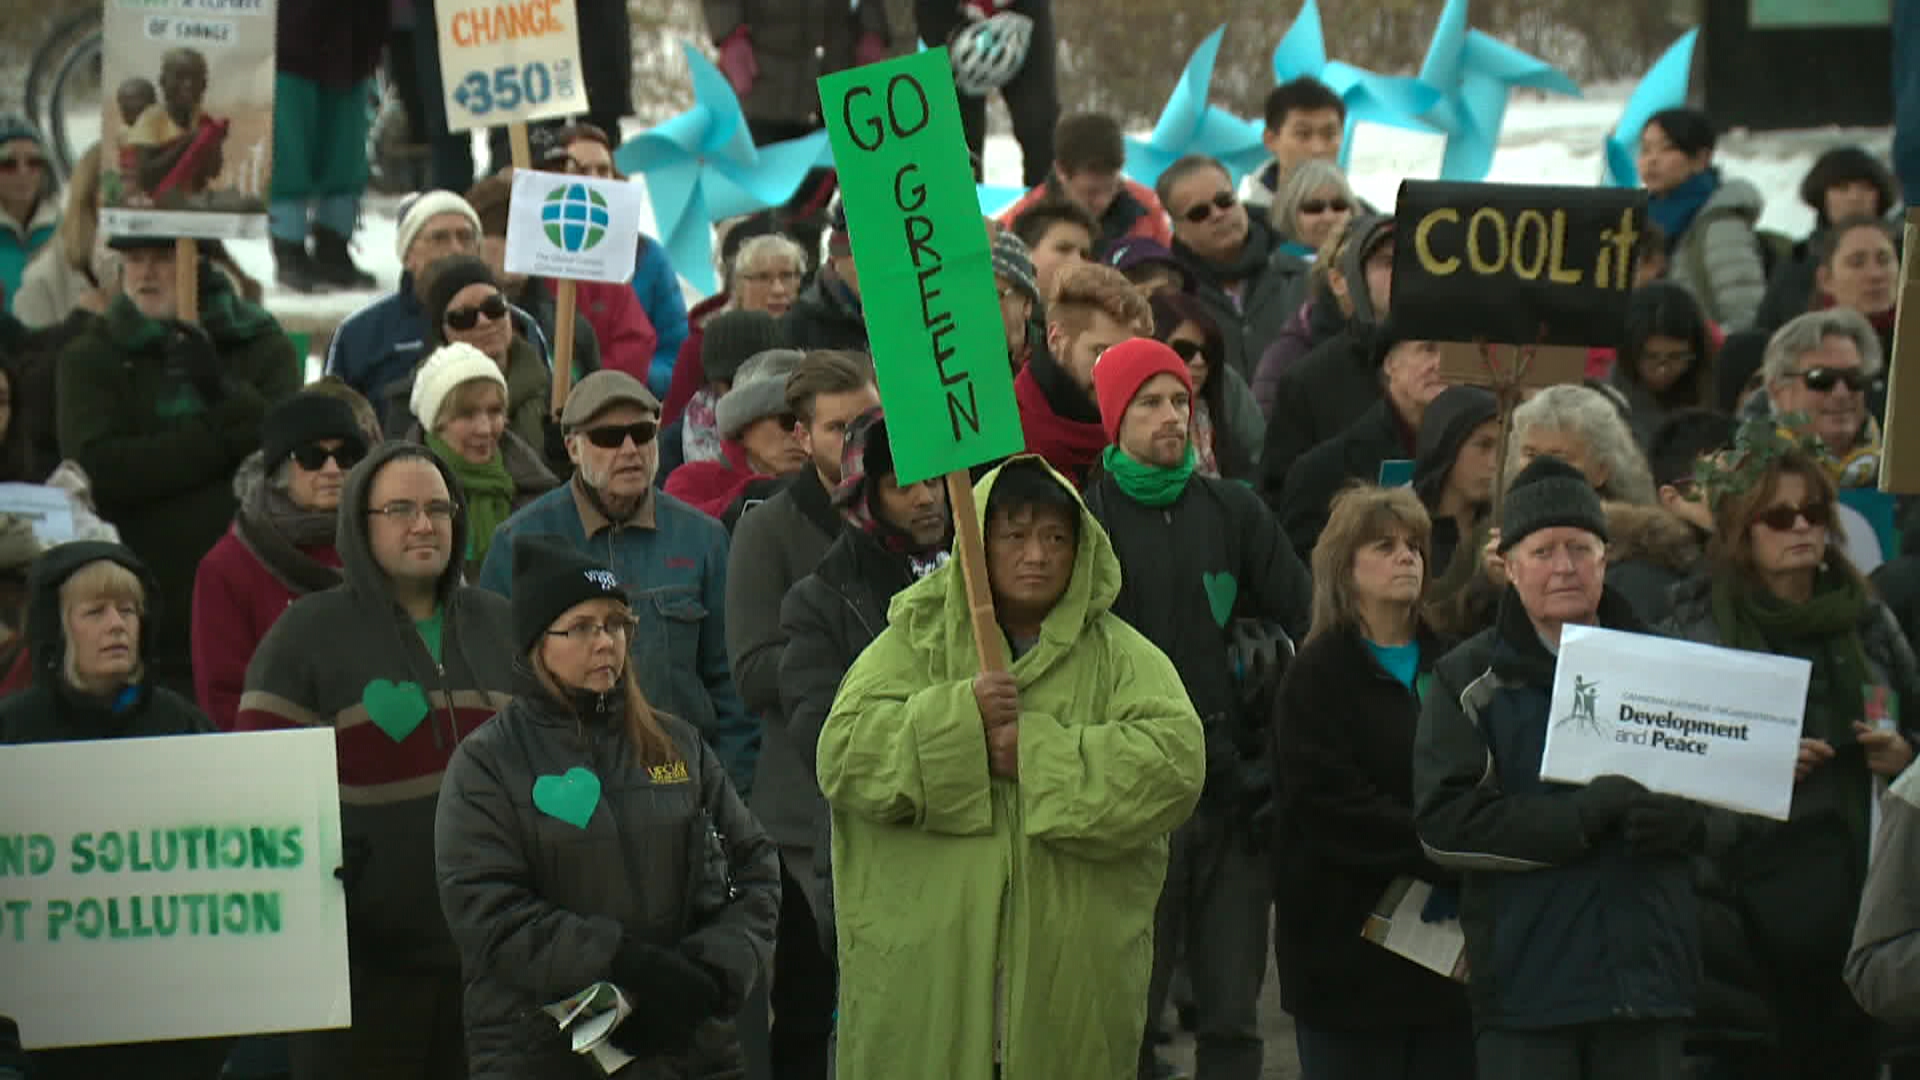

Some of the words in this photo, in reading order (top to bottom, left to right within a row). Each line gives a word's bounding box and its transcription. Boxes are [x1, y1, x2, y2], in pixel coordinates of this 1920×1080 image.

[452, 0, 565, 47] CHANGE
[464, 62, 551, 114] 350
[843, 73, 929, 151] GO
[1415, 206, 1584, 285] COOL
[1594, 207, 1640, 291] it
[894, 163, 980, 442] GREEN
[1615, 727, 1649, 746] and
[1650, 730, 1709, 757] Peace
[1618, 703, 1750, 742] Development
[71, 826, 305, 875] SOLUTIONS
[0, 901, 32, 942] T
[47, 891, 282, 942] POLLUTION
